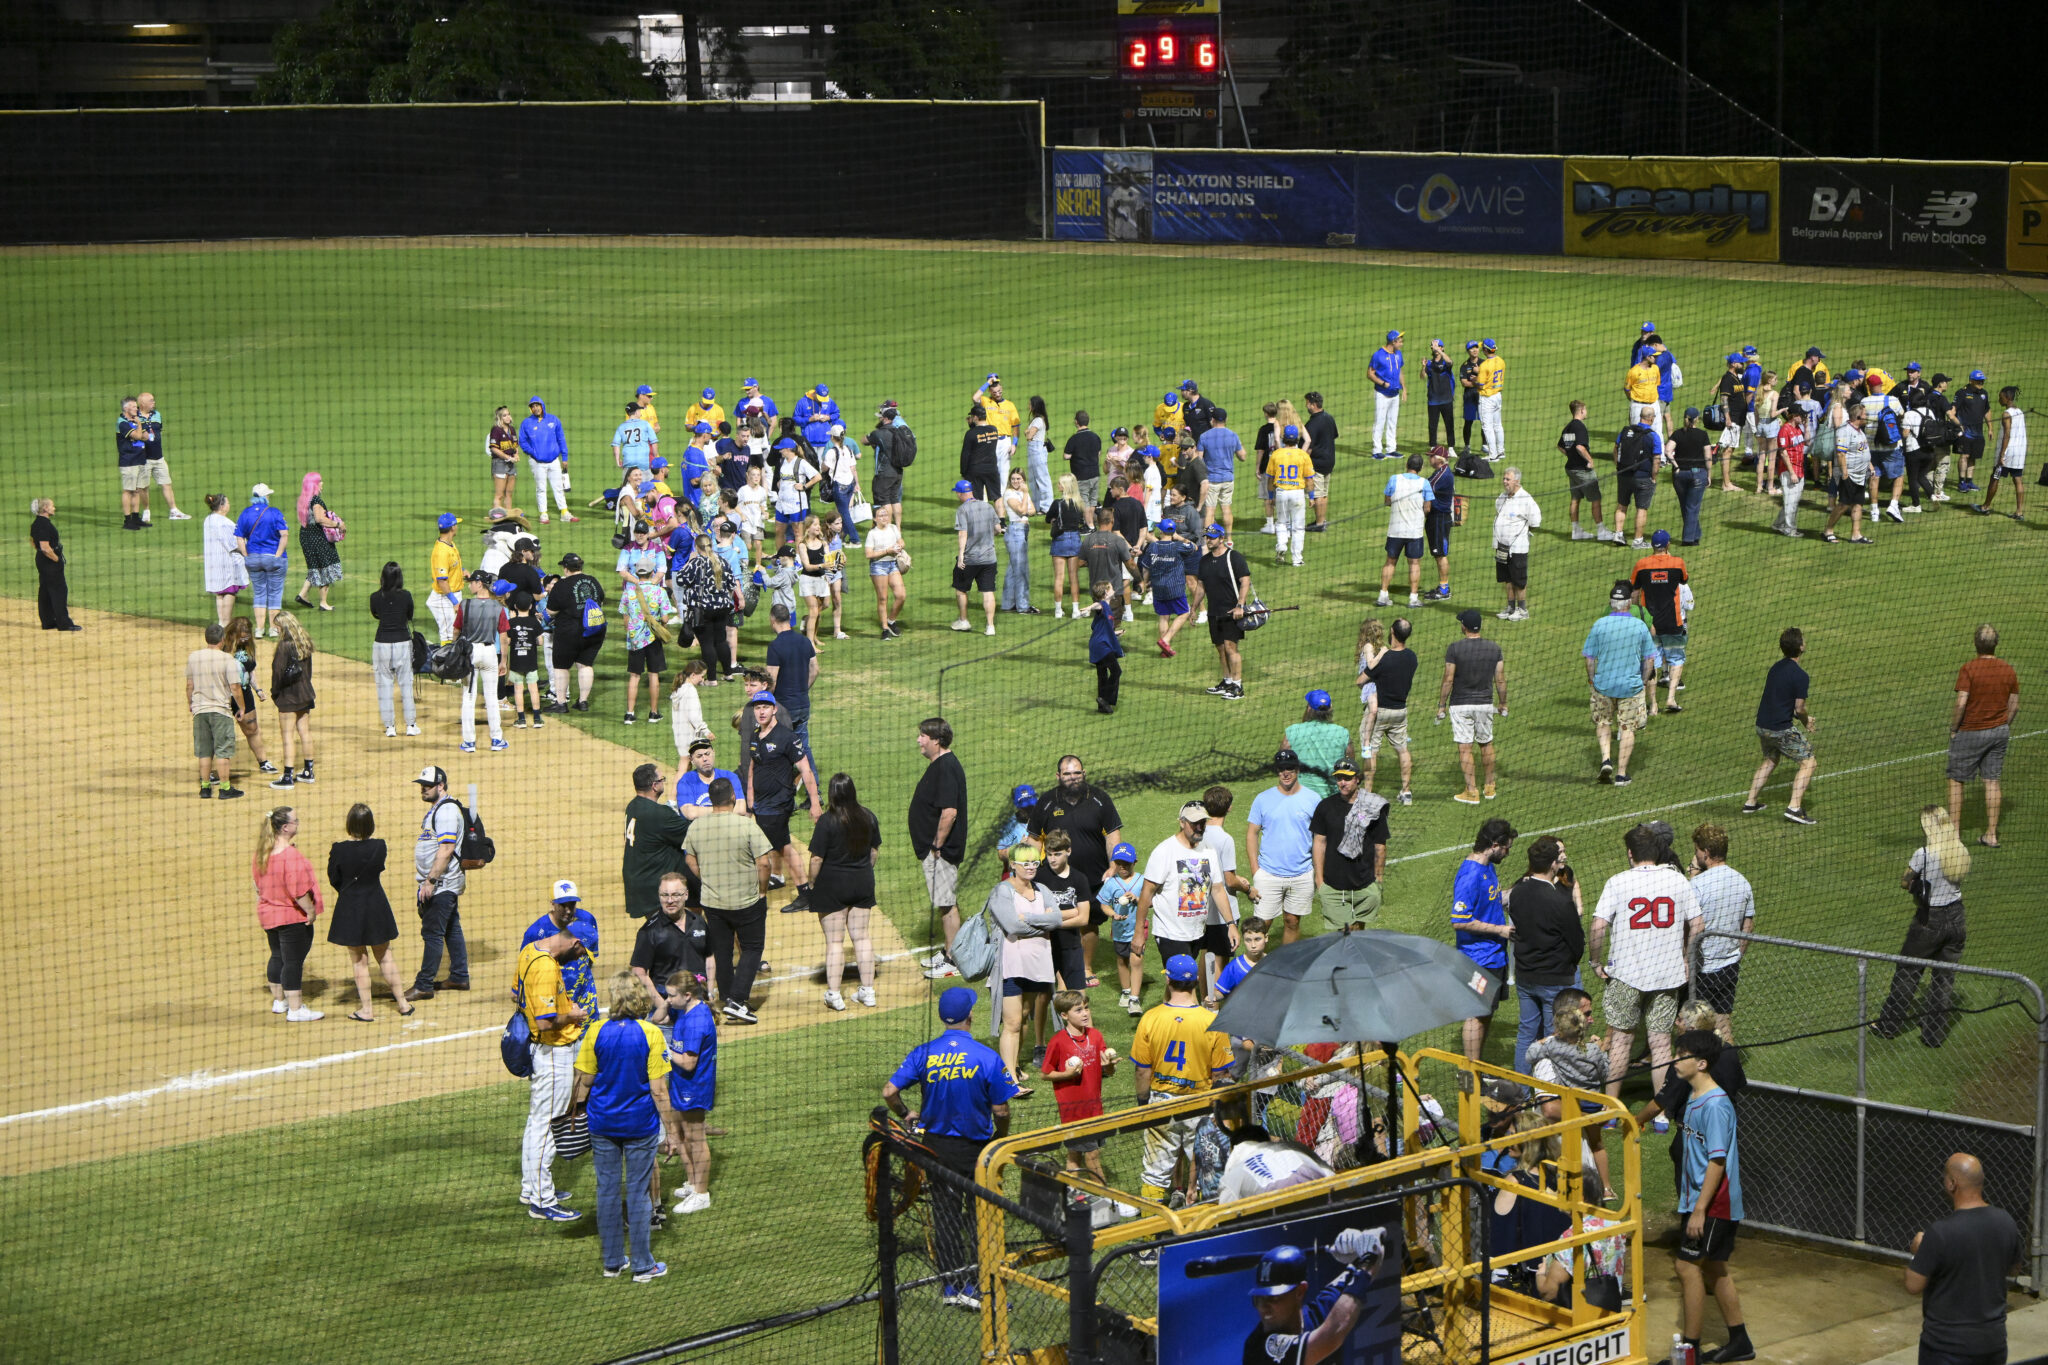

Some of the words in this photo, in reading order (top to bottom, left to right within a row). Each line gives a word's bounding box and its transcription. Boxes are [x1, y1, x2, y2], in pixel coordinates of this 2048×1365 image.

[1132, 43, 1147, 67] 2
[1159, 36, 1174, 60] 9
[1199, 43, 1214, 67] 6
[1137, 107, 1202, 117] STIMSON
[1155, 173, 1232, 188] CLAXTON
[1236, 175, 1294, 190] SHIELD
[1056, 188, 1101, 217] MERCH
[1155, 191, 1255, 206] CHAMPIONS
[1573, 181, 1771, 234] Ready
[1580, 205, 1746, 245] Towing
[1792, 226, 1839, 240] Belgravia
[1842, 228, 1883, 241] Apparel
[1902, 231, 1928, 243] new
[1931, 230, 1987, 245] balance
[624, 428, 641, 444] 73
[1278, 464, 1299, 480] 10
[625, 816, 637, 848] 4
[1628, 896, 1675, 931] 20
[926, 1052, 968, 1069] BLUE
[1163, 1040, 1187, 1071] 4
[926, 1065, 980, 1083] CREW
